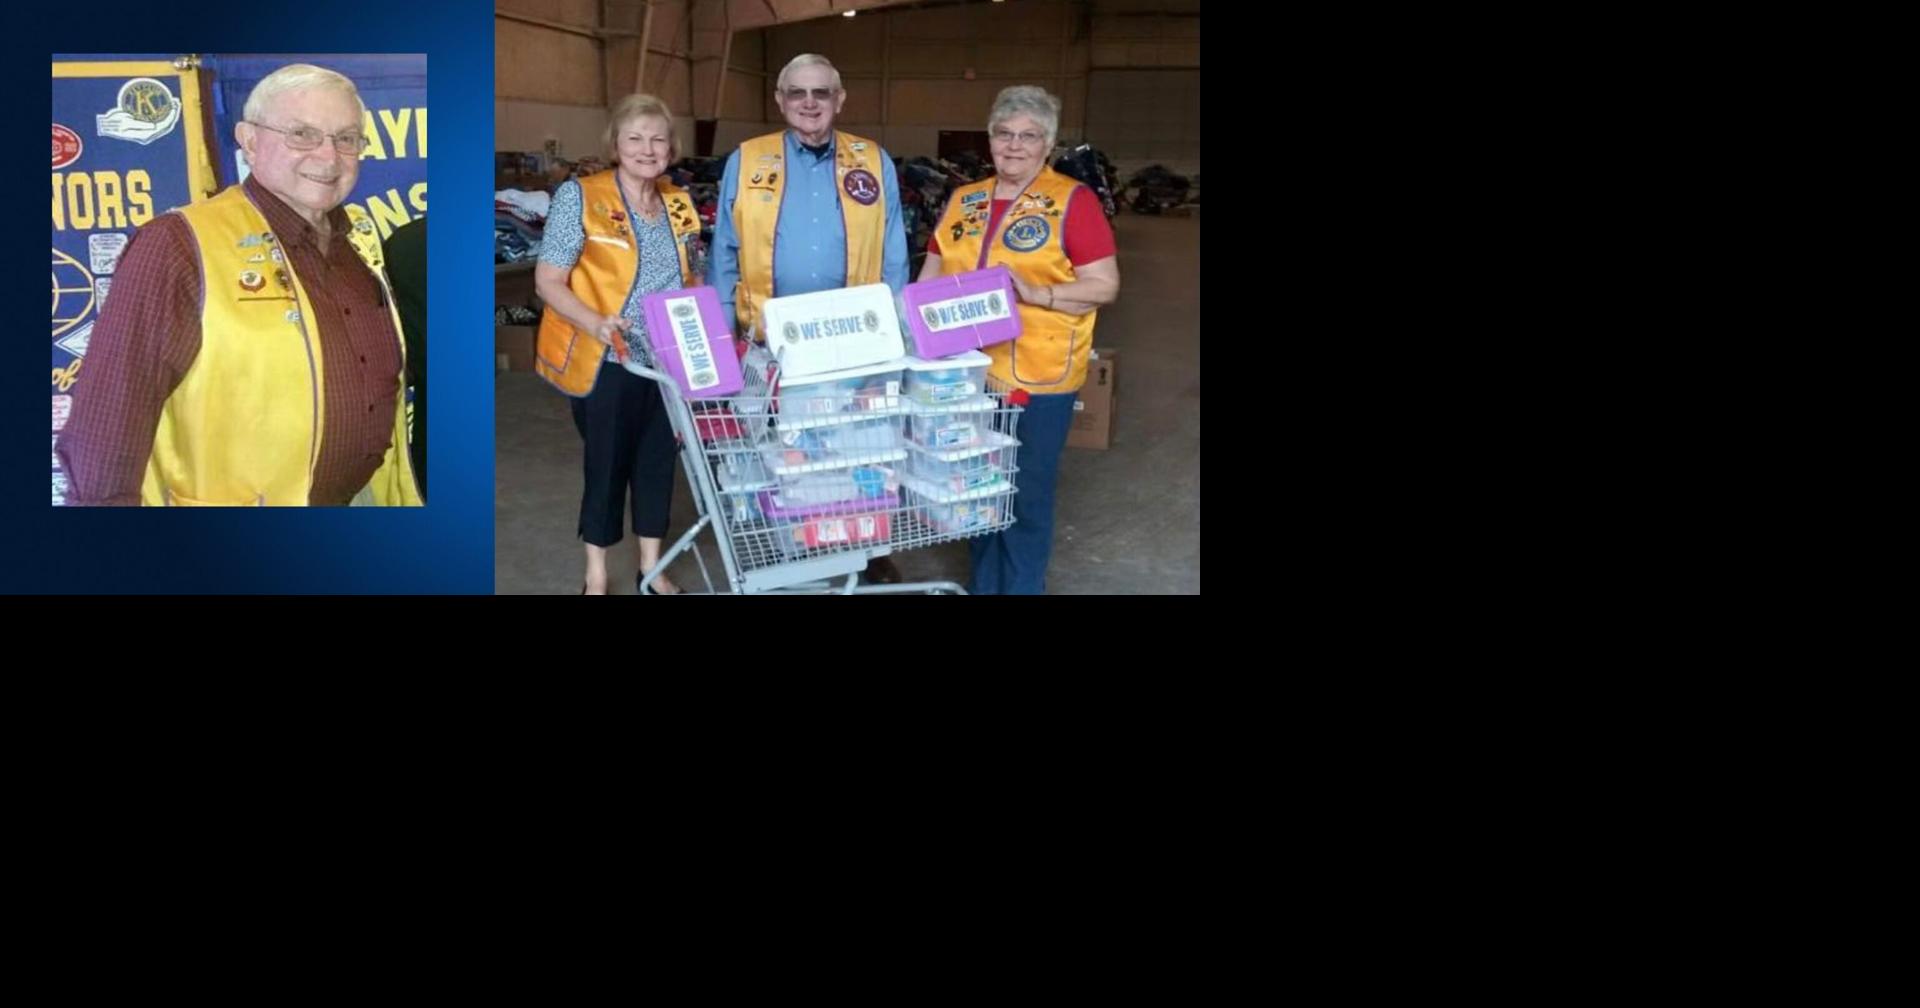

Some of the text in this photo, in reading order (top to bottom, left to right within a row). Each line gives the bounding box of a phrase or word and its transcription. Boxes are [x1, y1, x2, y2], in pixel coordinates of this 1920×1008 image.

[359, 107, 427, 160] AY
[938, 304, 960, 324] WE
[679, 317, 706, 353] SERVE
[800, 315, 863, 341] WE SERVE
[690, 351, 711, 371] WE
